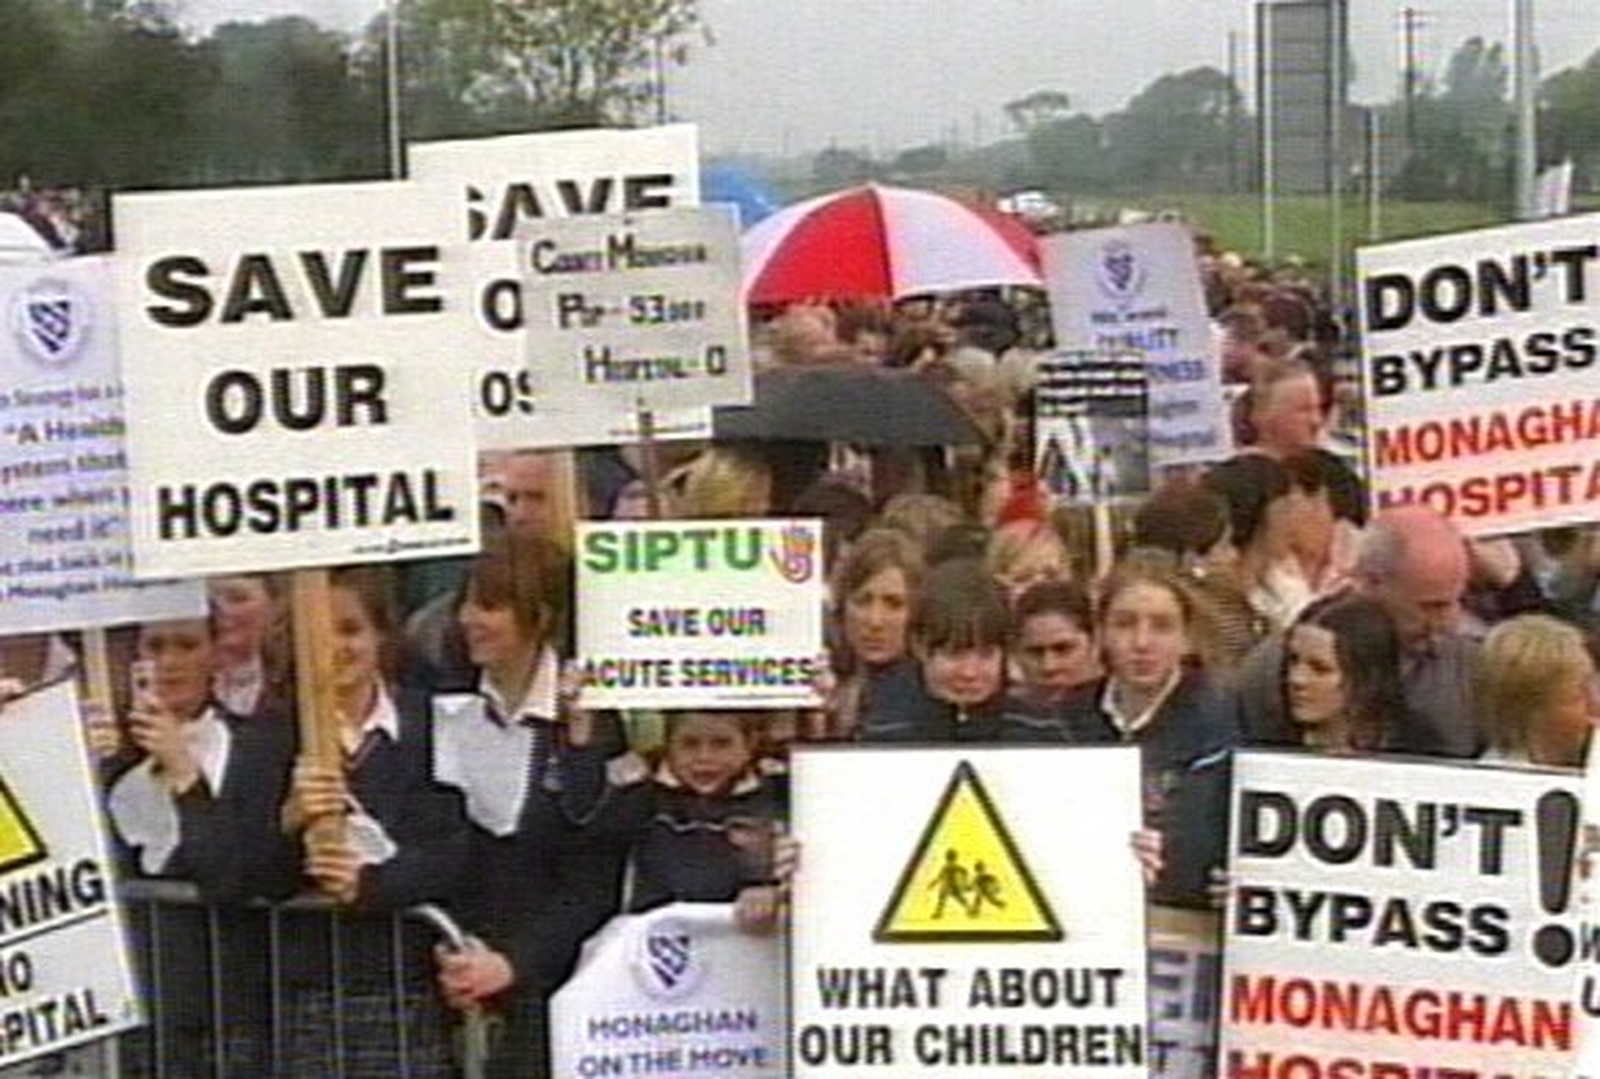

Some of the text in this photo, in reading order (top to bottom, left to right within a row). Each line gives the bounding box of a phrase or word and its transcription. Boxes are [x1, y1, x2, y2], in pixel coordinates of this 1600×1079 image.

[145, 246, 444, 329] SAVE
[1365, 245, 1599, 332] DON'T
[1371, 326, 1597, 397] BYPASS
[205, 363, 388, 435] OUR
[157, 469, 455, 540] HOSPITAL
[583, 527, 763, 573] SIPTU
[627, 607, 766, 637] SAVE OUR
[584, 656, 817, 689] ACUTE SERVICES
[1239, 788, 1522, 876] DON'T
[1235, 885, 1510, 957] BYPASS
[0, 988, 108, 1055] PITAL
[816, 967, 946, 1009] WHAT
[968, 967, 1124, 1009] ABOUT
[1230, 974, 1572, 1051] MONAGHAN
[588, 1006, 758, 1040] MONAGHAN
[799, 1024, 893, 1065] OUR
[914, 1024, 1144, 1065] CHILDREN
[577, 1047, 766, 1079] ON THE MOVE
